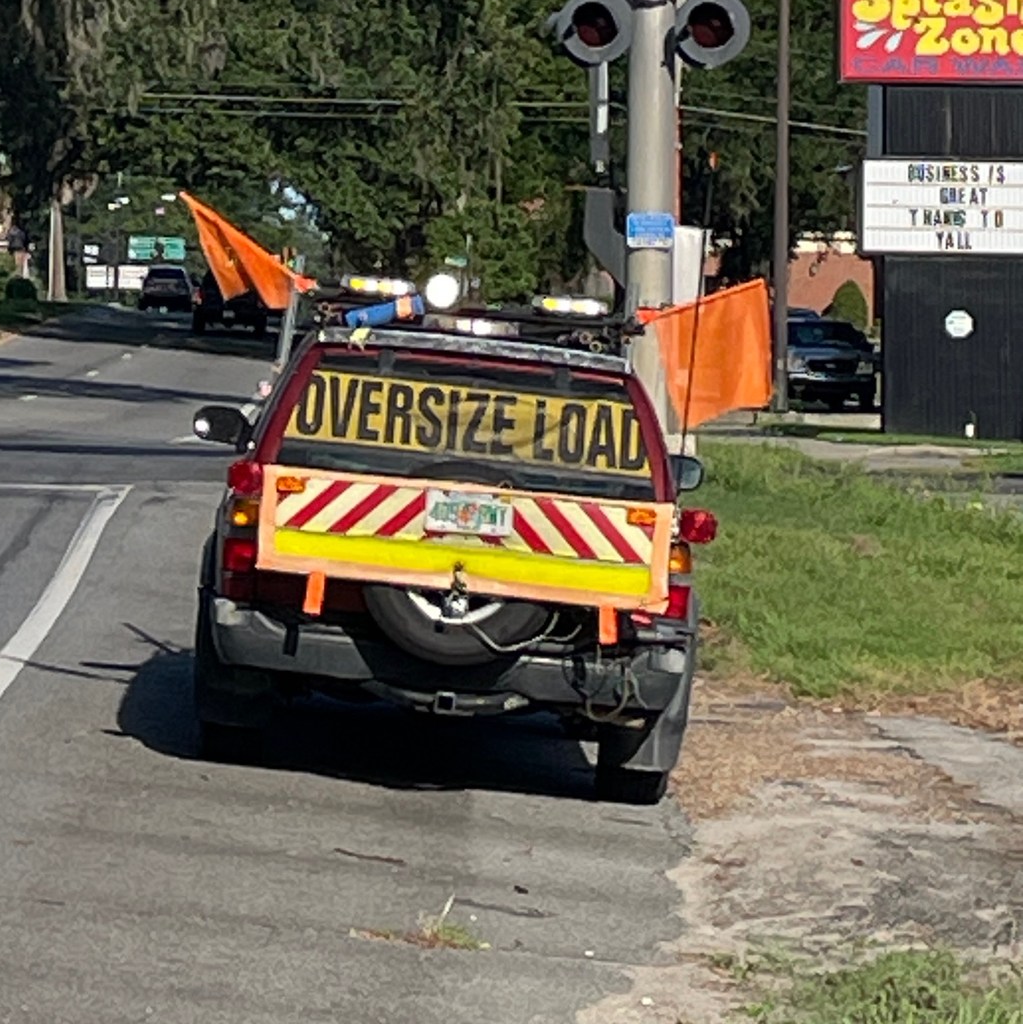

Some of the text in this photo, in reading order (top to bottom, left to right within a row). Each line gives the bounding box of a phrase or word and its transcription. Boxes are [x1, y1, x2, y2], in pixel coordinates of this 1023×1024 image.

[853, 56, 939, 74] CAR
[908, 163, 1005, 185] BUSINESS IS
[939, 187, 988, 206] GREAT
[909, 208, 1004, 228] THANKS TO
[936, 231, 972, 250] YALL
[295, 374, 650, 470] OVERSIZE LOAD
